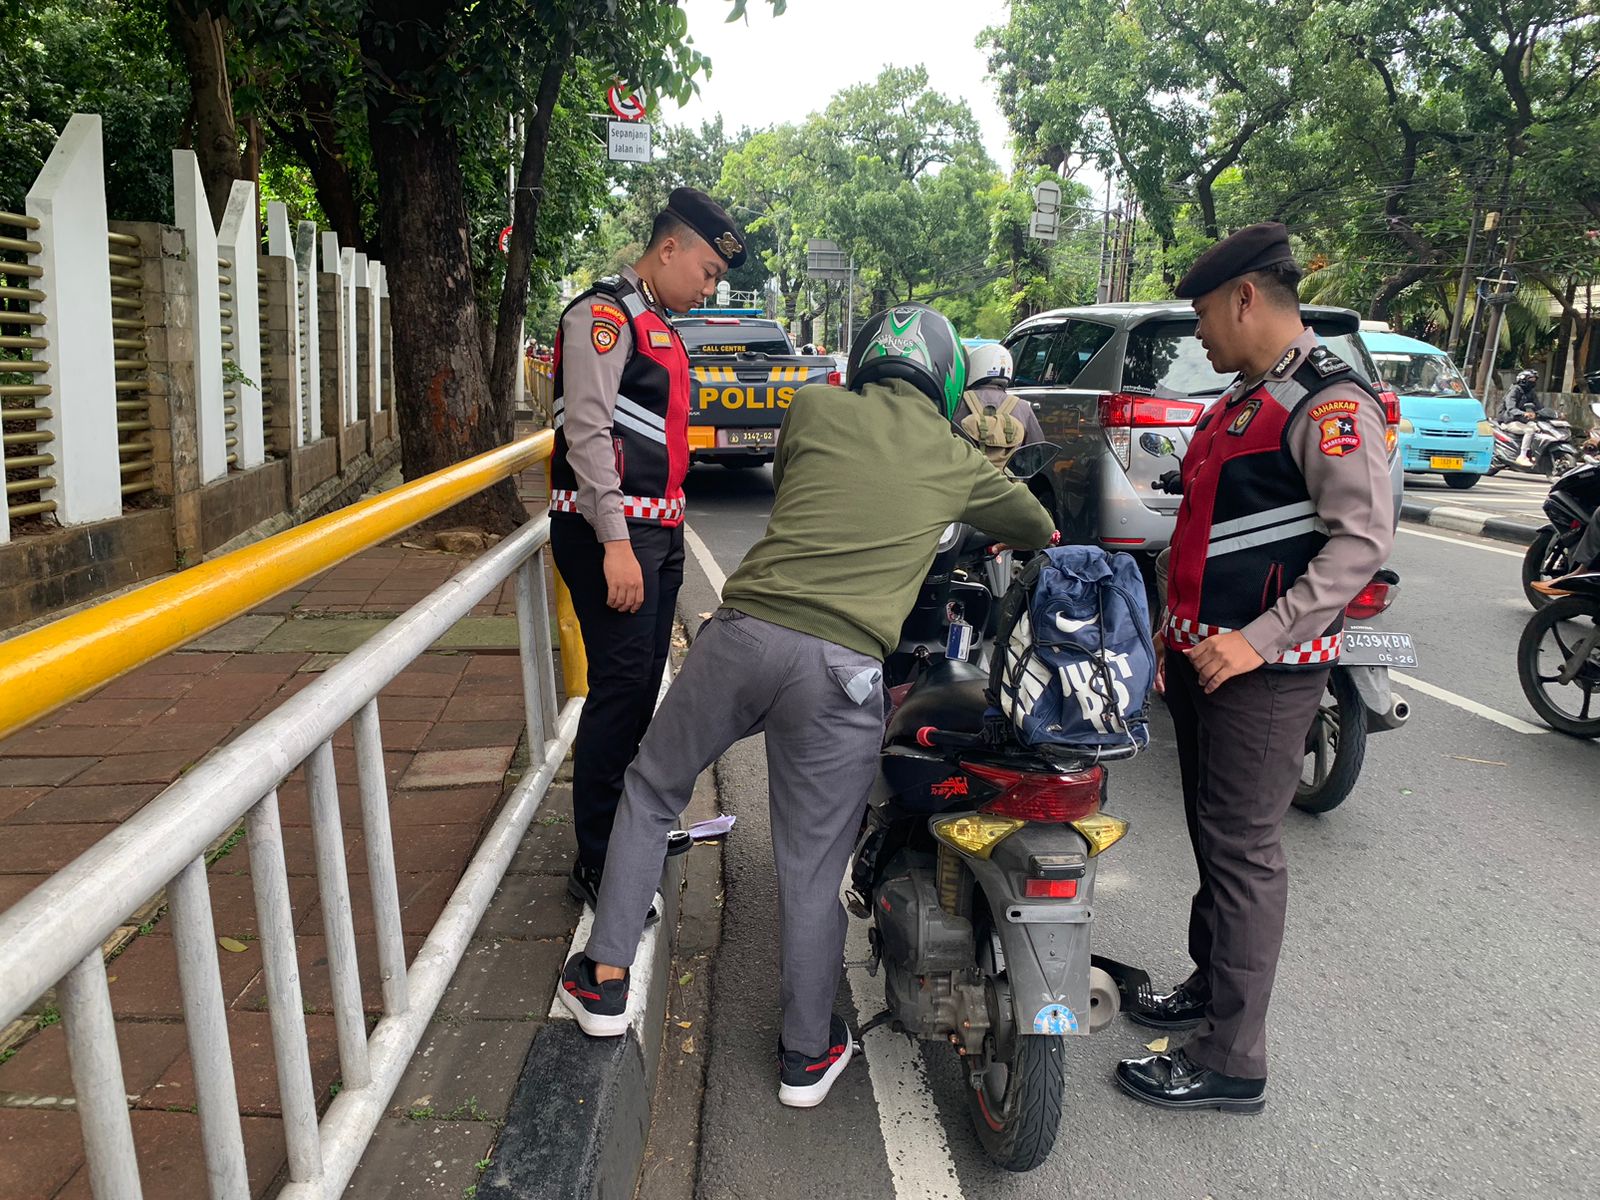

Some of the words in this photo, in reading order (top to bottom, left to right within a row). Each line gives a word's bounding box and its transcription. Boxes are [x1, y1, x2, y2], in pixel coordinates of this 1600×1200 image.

[611, 128, 648, 141] Sepanjang
[614, 143, 634, 153] Jalan
[635, 144, 645, 154] ini
[887, 335, 914, 347] KINGS
[1312, 401, 1356, 418] BAHARKAM
